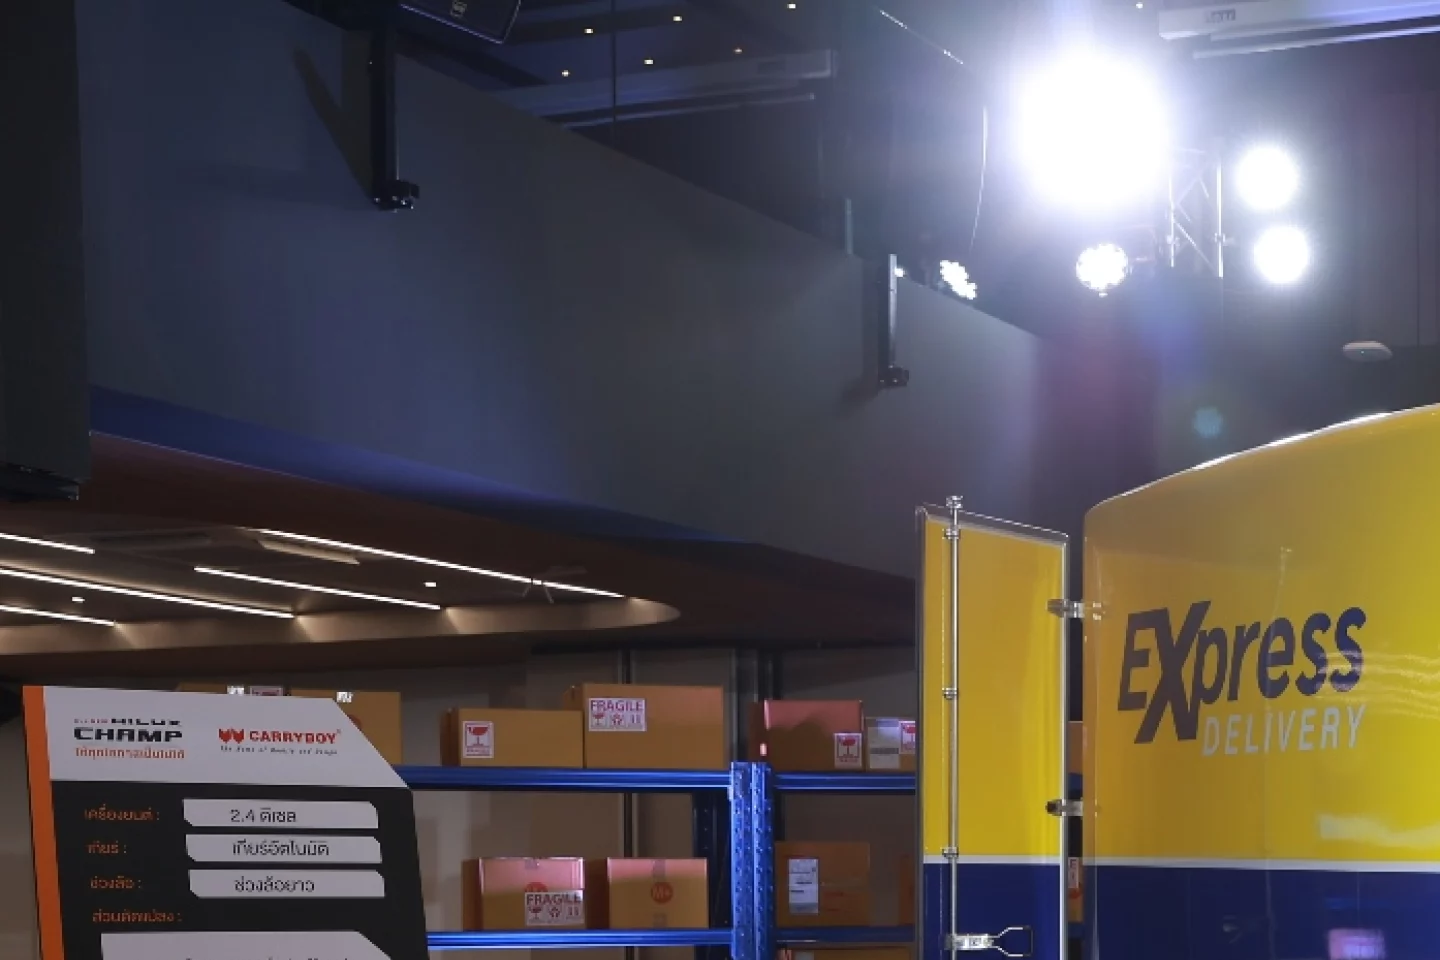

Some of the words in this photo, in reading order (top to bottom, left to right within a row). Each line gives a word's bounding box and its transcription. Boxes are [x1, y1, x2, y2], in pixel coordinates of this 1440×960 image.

[1118, 601, 1367, 744] EXpress
[590, 700, 643, 711] FRAGILE
[74, 727, 183, 742] CHAMP
[249, 730, 337, 744] CARRYBOY
[1203, 705, 1366, 757] DELIVERY
[230, 809, 255, 823] 2.4
[260, 807, 297, 823] ดีเซล
[234, 876, 315, 893] ช่วงล้อยาว
[526, 893, 582, 906] FRAGILE
